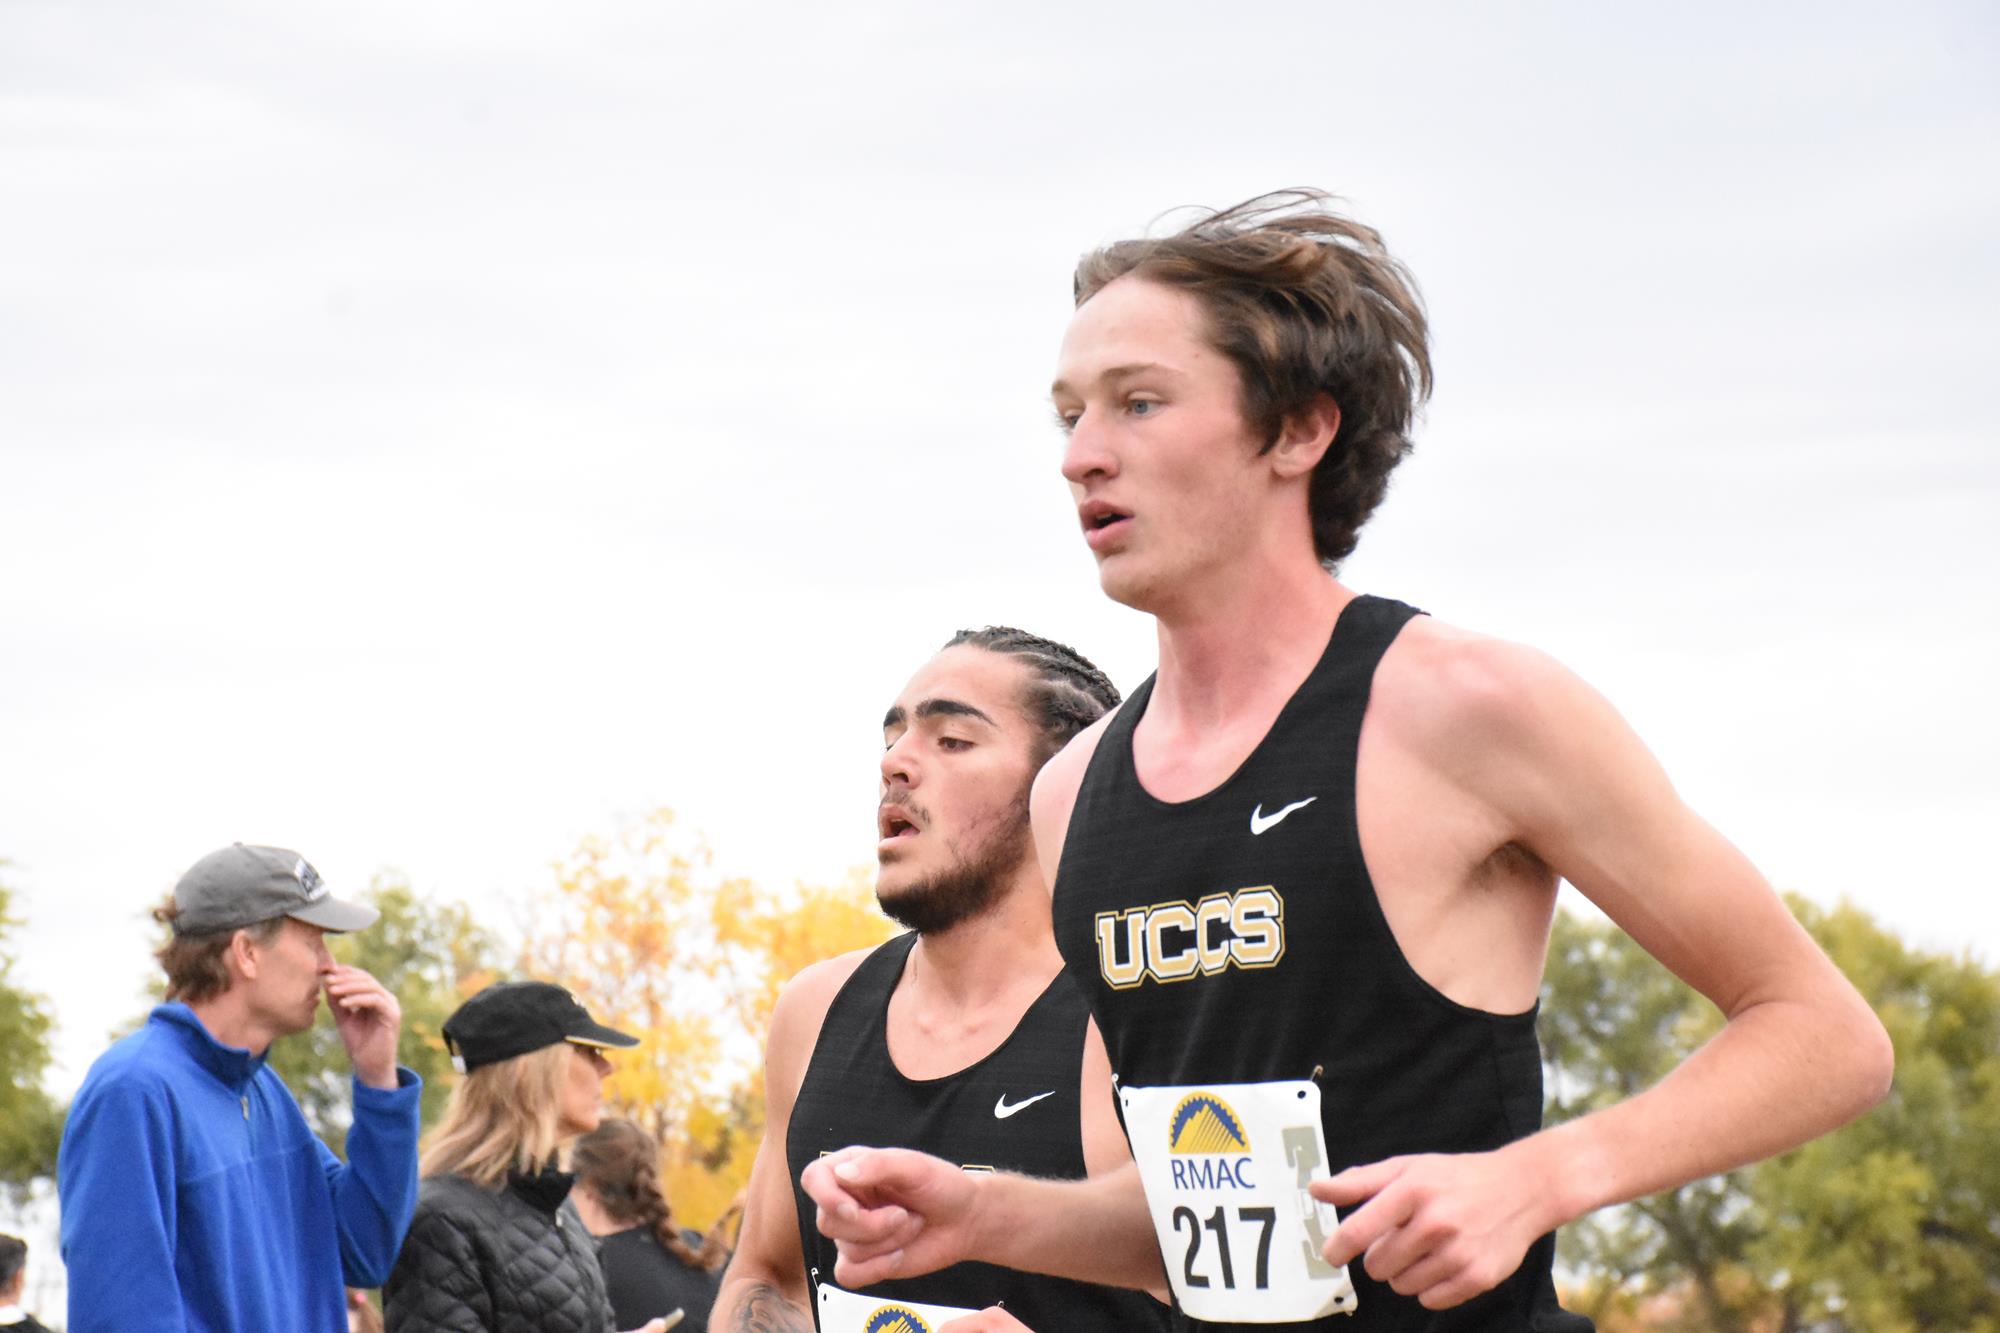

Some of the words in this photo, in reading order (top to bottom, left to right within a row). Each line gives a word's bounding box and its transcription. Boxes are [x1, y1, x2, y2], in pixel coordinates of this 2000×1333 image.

[1095, 885, 1285, 990] UCCS
[1171, 1157, 1256, 1190] RMAC
[1173, 1205, 1276, 1290] 217
